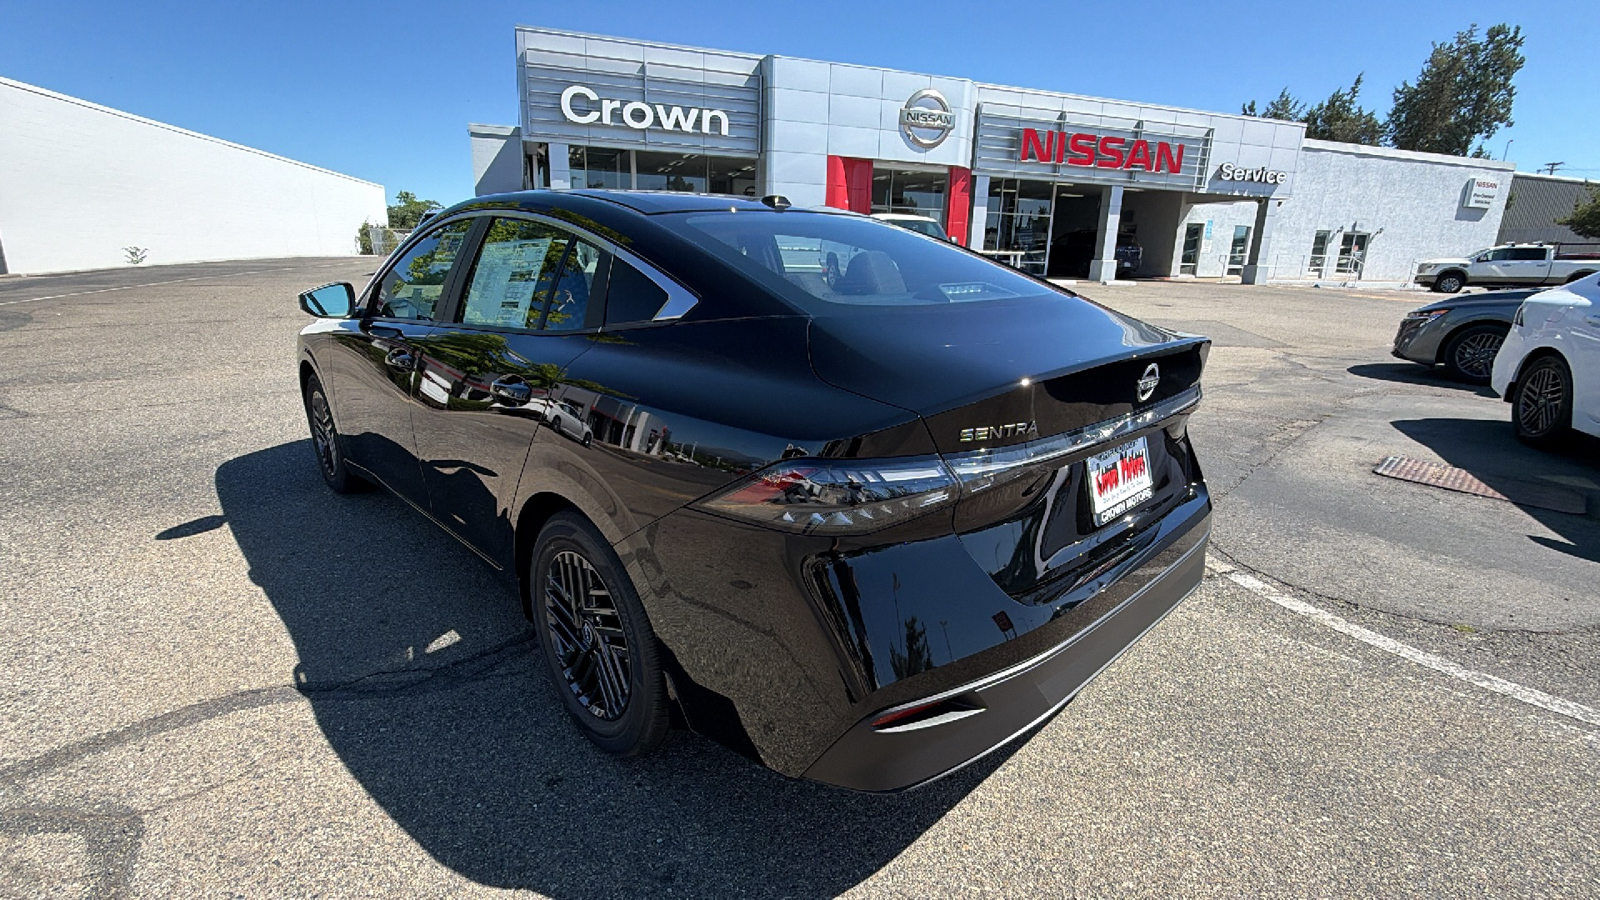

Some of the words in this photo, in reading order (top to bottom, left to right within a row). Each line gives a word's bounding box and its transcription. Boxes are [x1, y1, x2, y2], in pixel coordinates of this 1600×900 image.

[561, 85, 729, 136] Crown
[906, 112, 952, 125] NISSAN
[1021, 128, 1184, 174] NISSAN
[1220, 163, 1287, 185] Service
[960, 420, 1037, 441] SENTRA
[1101, 502, 1125, 522] CROWN
[1126, 487, 1153, 509] MOTORS
